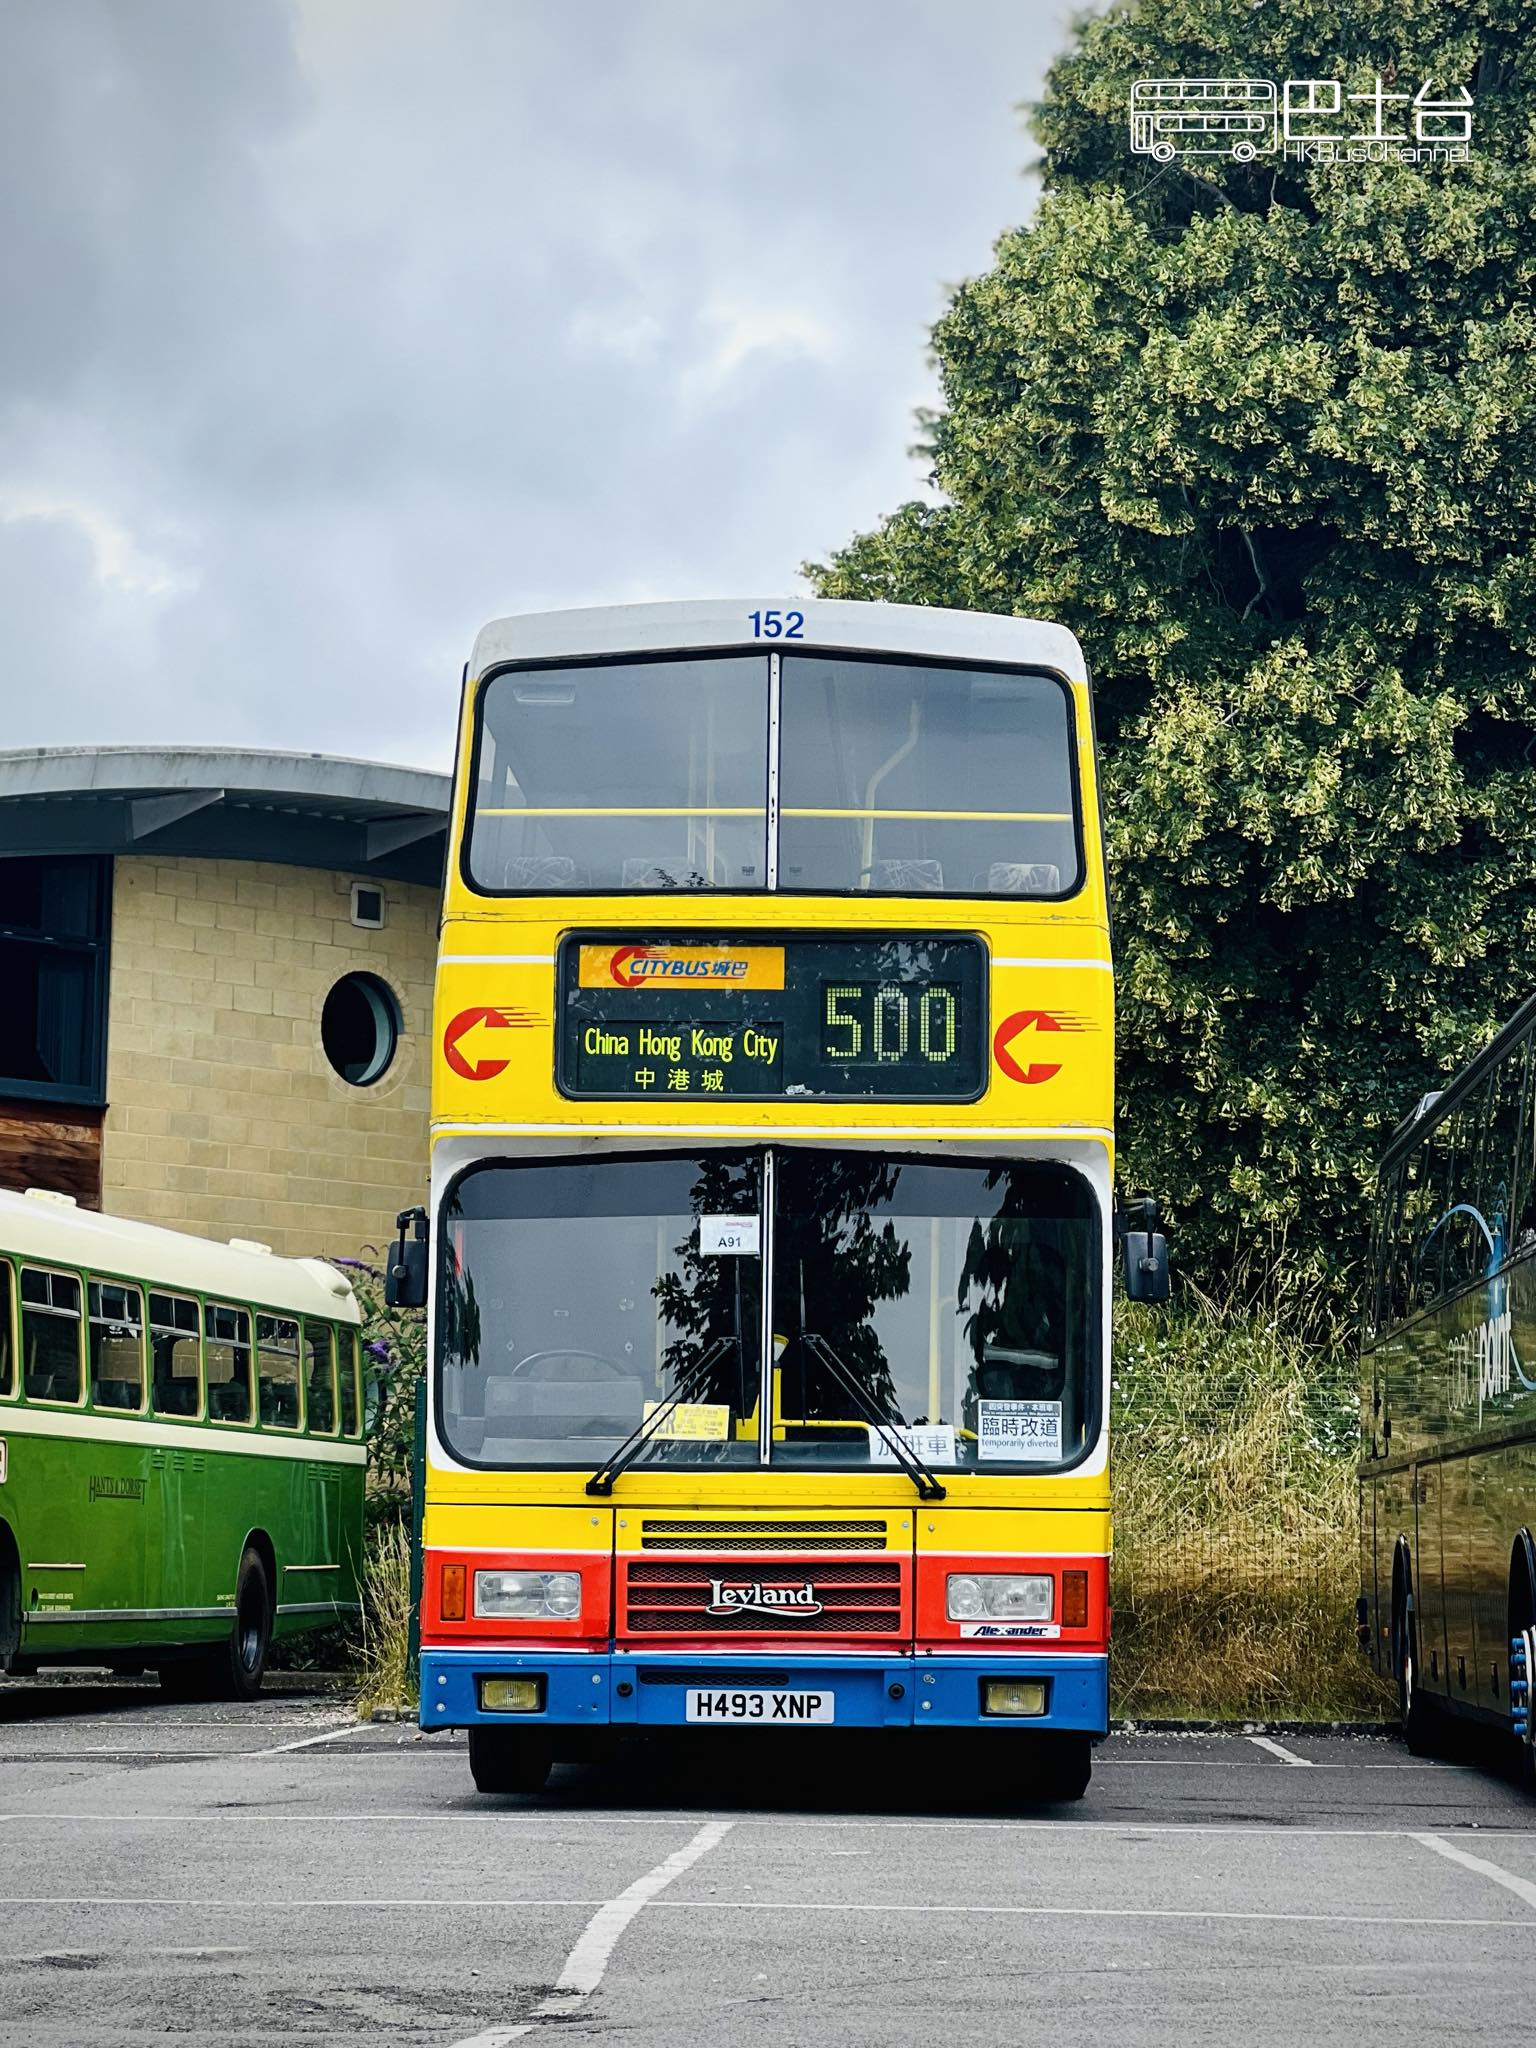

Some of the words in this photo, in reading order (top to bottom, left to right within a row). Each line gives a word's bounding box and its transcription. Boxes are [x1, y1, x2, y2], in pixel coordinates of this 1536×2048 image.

[748, 610, 804, 638] 152
[630, 960, 710, 976] CITYBUS
[827, 987, 955, 1061] 500
[585, 1027, 629, 1055] China
[639, 1029, 681, 1062] Hong
[691, 1029, 733, 1062] Kong
[743, 1029, 778, 1065] City
[635, 1067, 724, 1091] 中港城
[718, 1236, 741, 1247] A91
[983, 1417, 1058, 1437] 臨時改道
[982, 1439, 1025, 1450] temporarily
[1027, 1439, 1059, 1448] diverted
[705, 1579, 823, 1617] Leyland
[697, 1693, 764, 1718] H493
[772, 1694, 822, 1718] XNP
